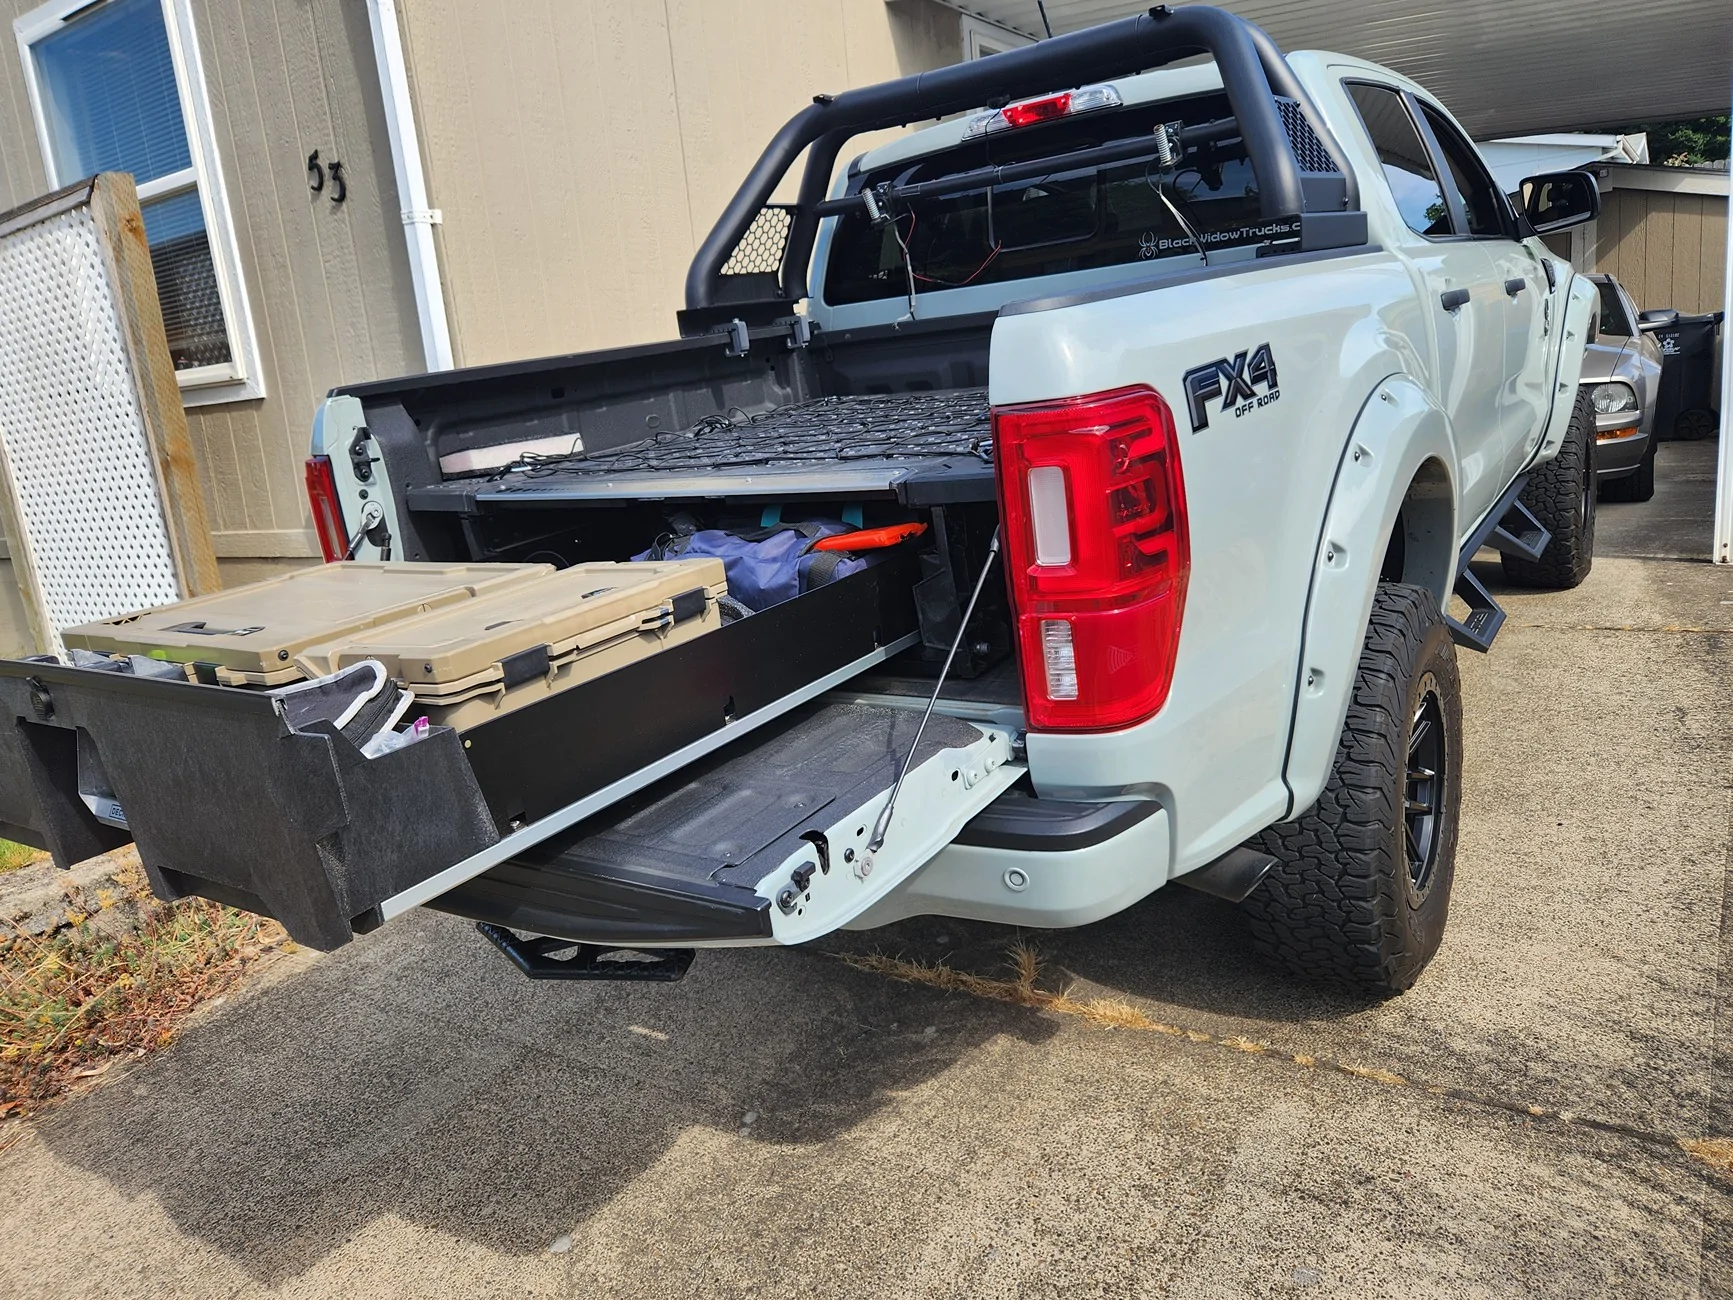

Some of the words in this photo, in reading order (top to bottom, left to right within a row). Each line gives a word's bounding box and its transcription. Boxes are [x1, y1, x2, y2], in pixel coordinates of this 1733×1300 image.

[308, 149, 346, 203] 53
[1182, 341, 1279, 435] FX4
[1234, 401, 1255, 418] OFF
[1257, 389, 1280, 409] ROAD
